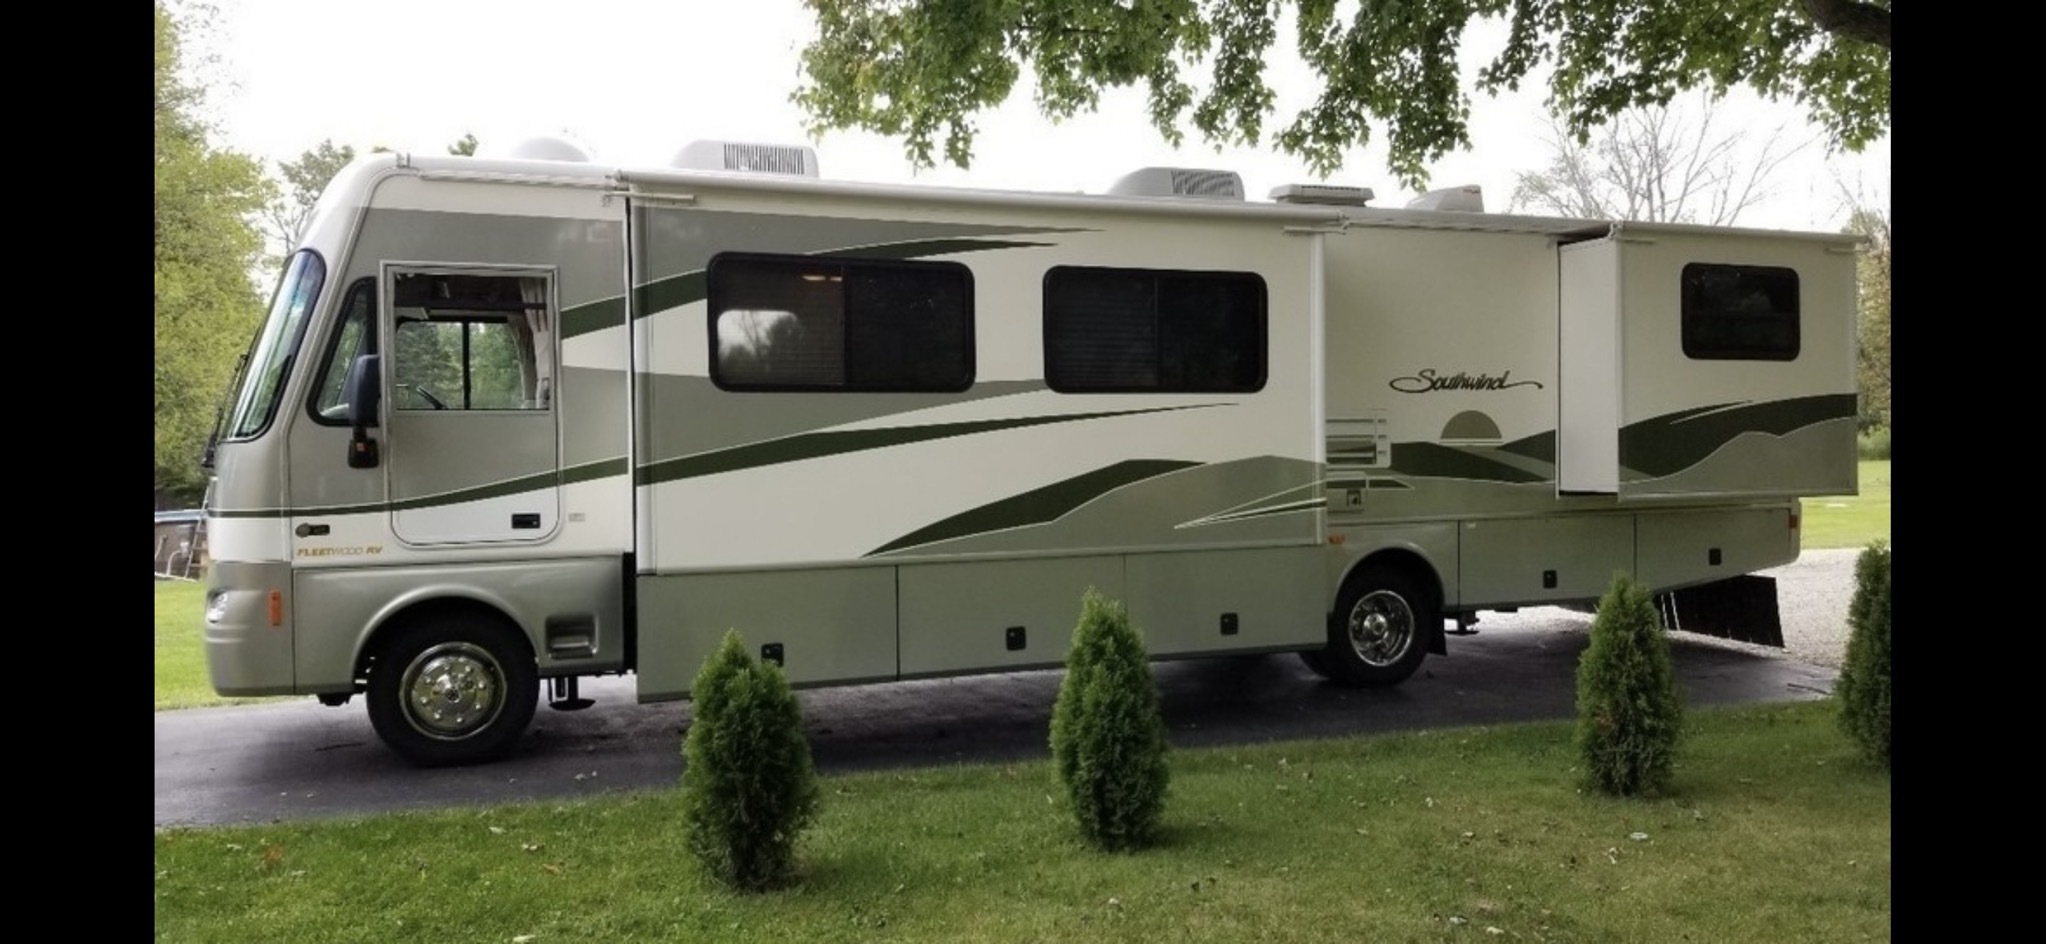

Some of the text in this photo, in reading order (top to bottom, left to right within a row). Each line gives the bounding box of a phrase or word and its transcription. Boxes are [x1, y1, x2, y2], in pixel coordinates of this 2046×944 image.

[1389, 368, 1543, 393] Southwind
[297, 545, 383, 557] FLEETWOOD RV
